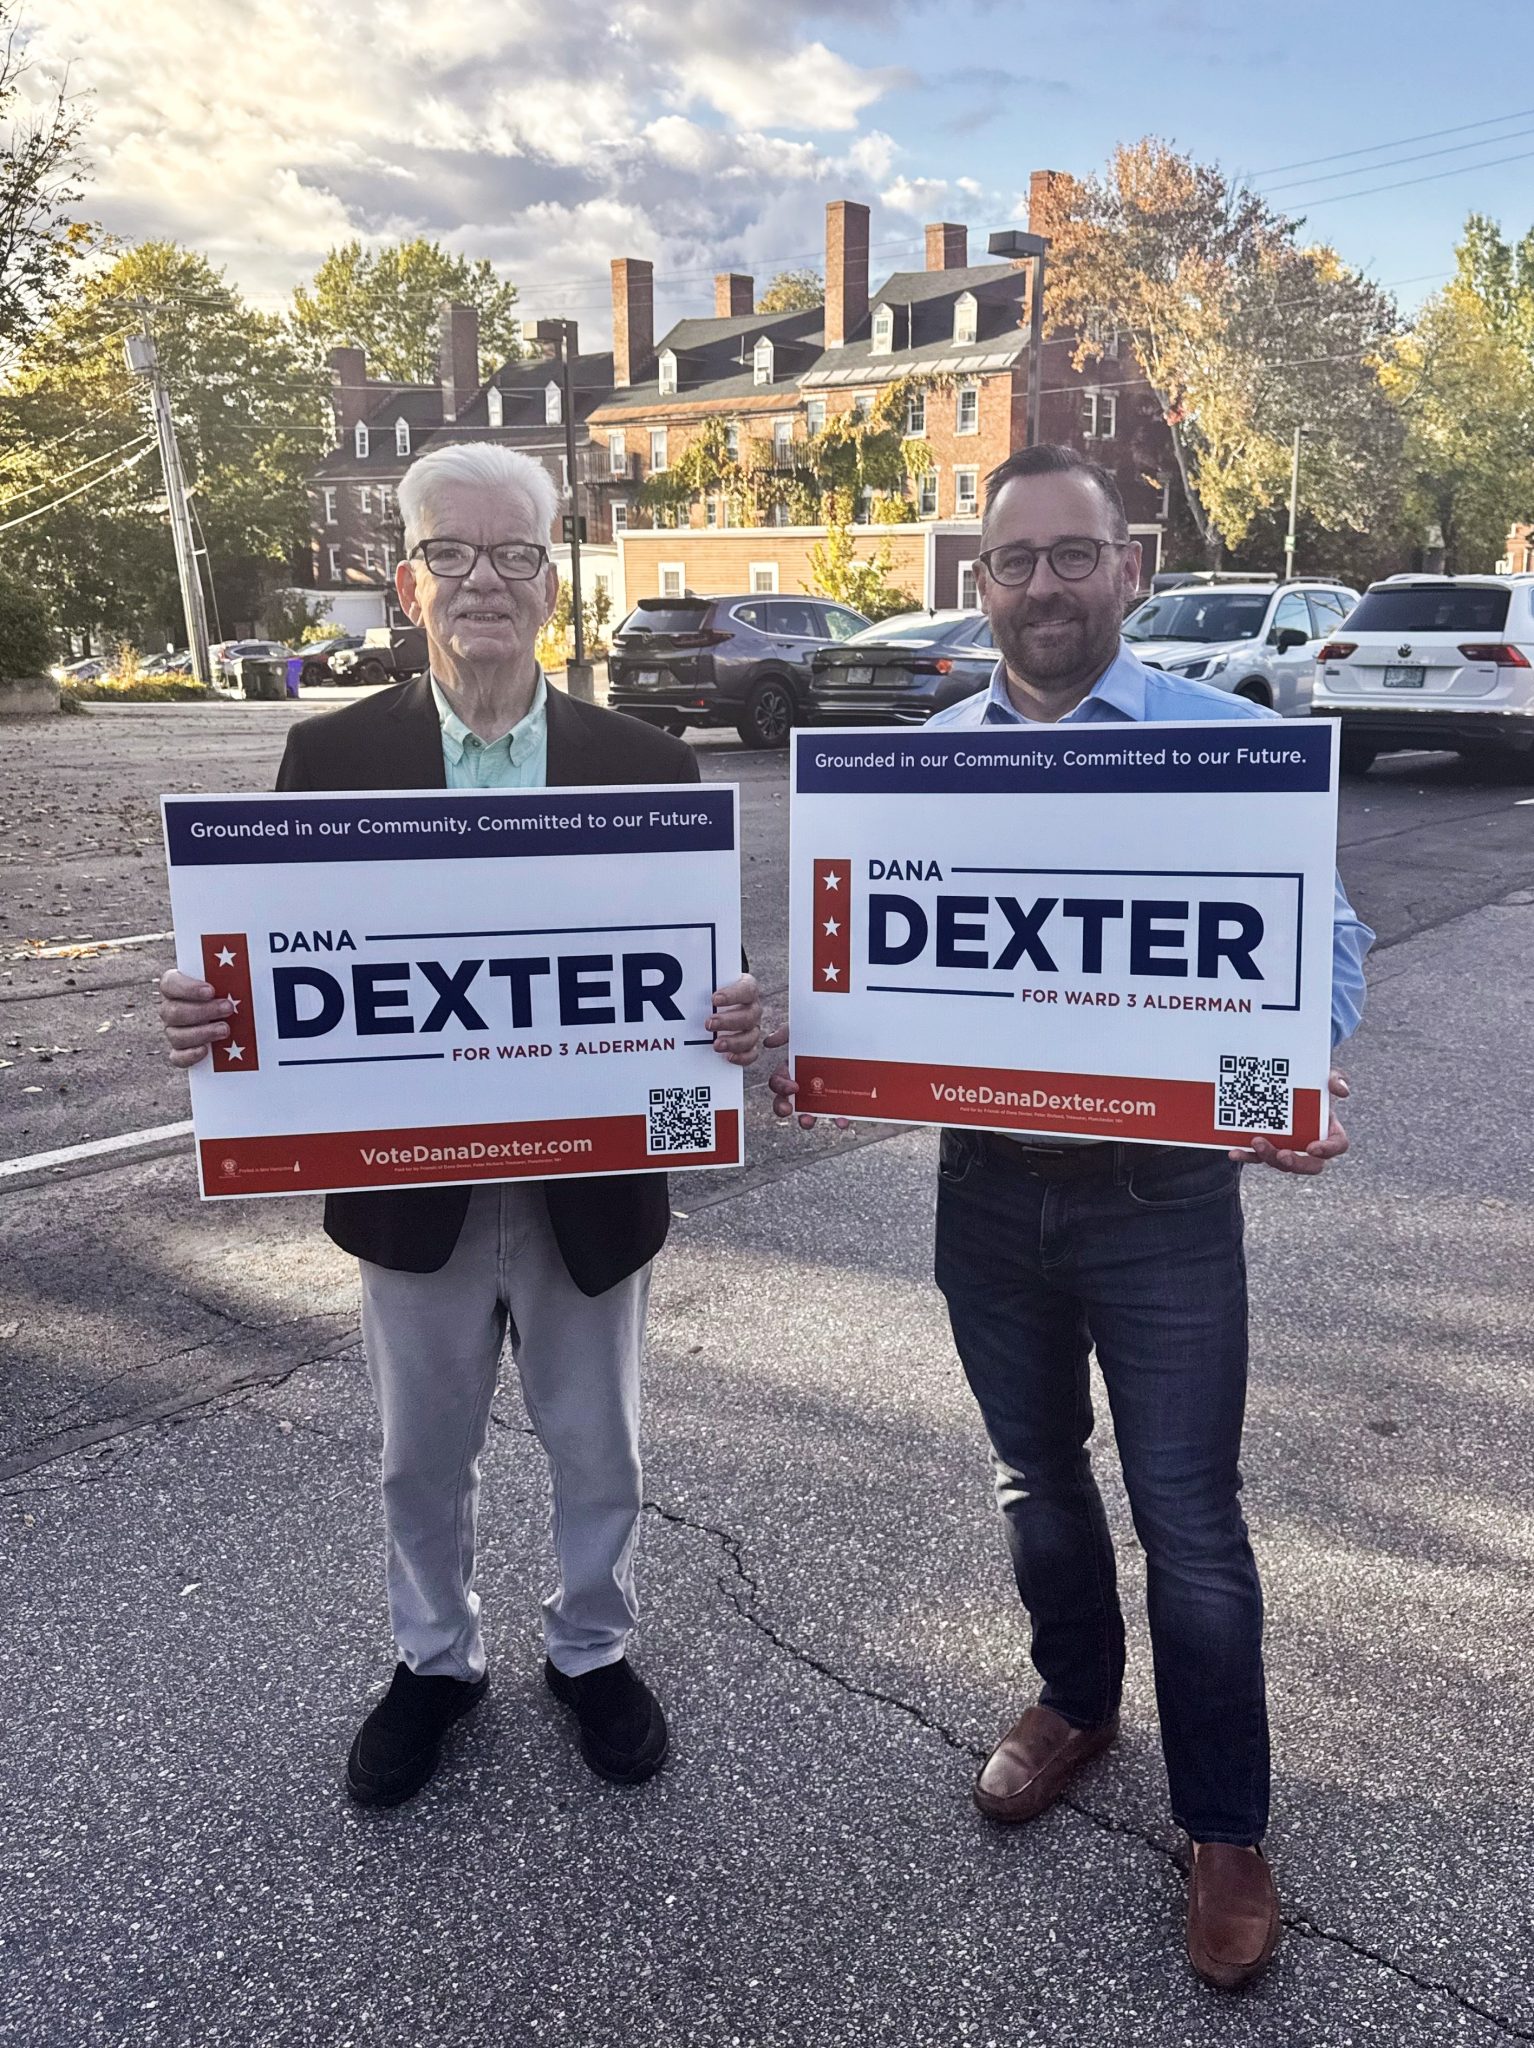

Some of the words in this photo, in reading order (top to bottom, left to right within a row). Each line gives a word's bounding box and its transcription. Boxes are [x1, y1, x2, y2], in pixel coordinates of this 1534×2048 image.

[815, 752, 895, 768] Grounded
[900, 752, 915, 768] in
[920, 755, 949, 768] our
[953, 750, 1057, 770] Community.
[1063, 748, 1166, 766] Committed
[1171, 749, 1192, 765] to
[1197, 751, 1231, 765] our
[1237, 748, 1307, 764] Future.
[190, 819, 289, 838] Grounded
[295, 819, 313, 836] in
[318, 822, 352, 835] our
[357, 816, 472, 835] Community.
[477, 813, 582, 832] Committed
[587, 813, 607, 829] to
[612, 815, 644, 828] our
[649, 811, 713, 827] Future.
[868, 859, 944, 882] DANA
[268, 929, 358, 954] DANA
[868, 893, 1265, 981] DEXTER
[271, 951, 686, 1039] DEXTER
[1022, 988, 1058, 1005] FOR
[1064, 990, 1121, 1007] WARD
[1126, 993, 1137, 1008] 3
[1143, 994, 1252, 1014] ALDERMAN
[452, 1046, 491, 1062] FOR
[495, 1043, 553, 1060] WARD
[559, 1042, 569, 1057] 3
[574, 1037, 675, 1056] ALDERMAN
[930, 1082, 1156, 1116] VoteDanaDexter.com
[360, 1138, 593, 1166] VoteDanaDexter.com
